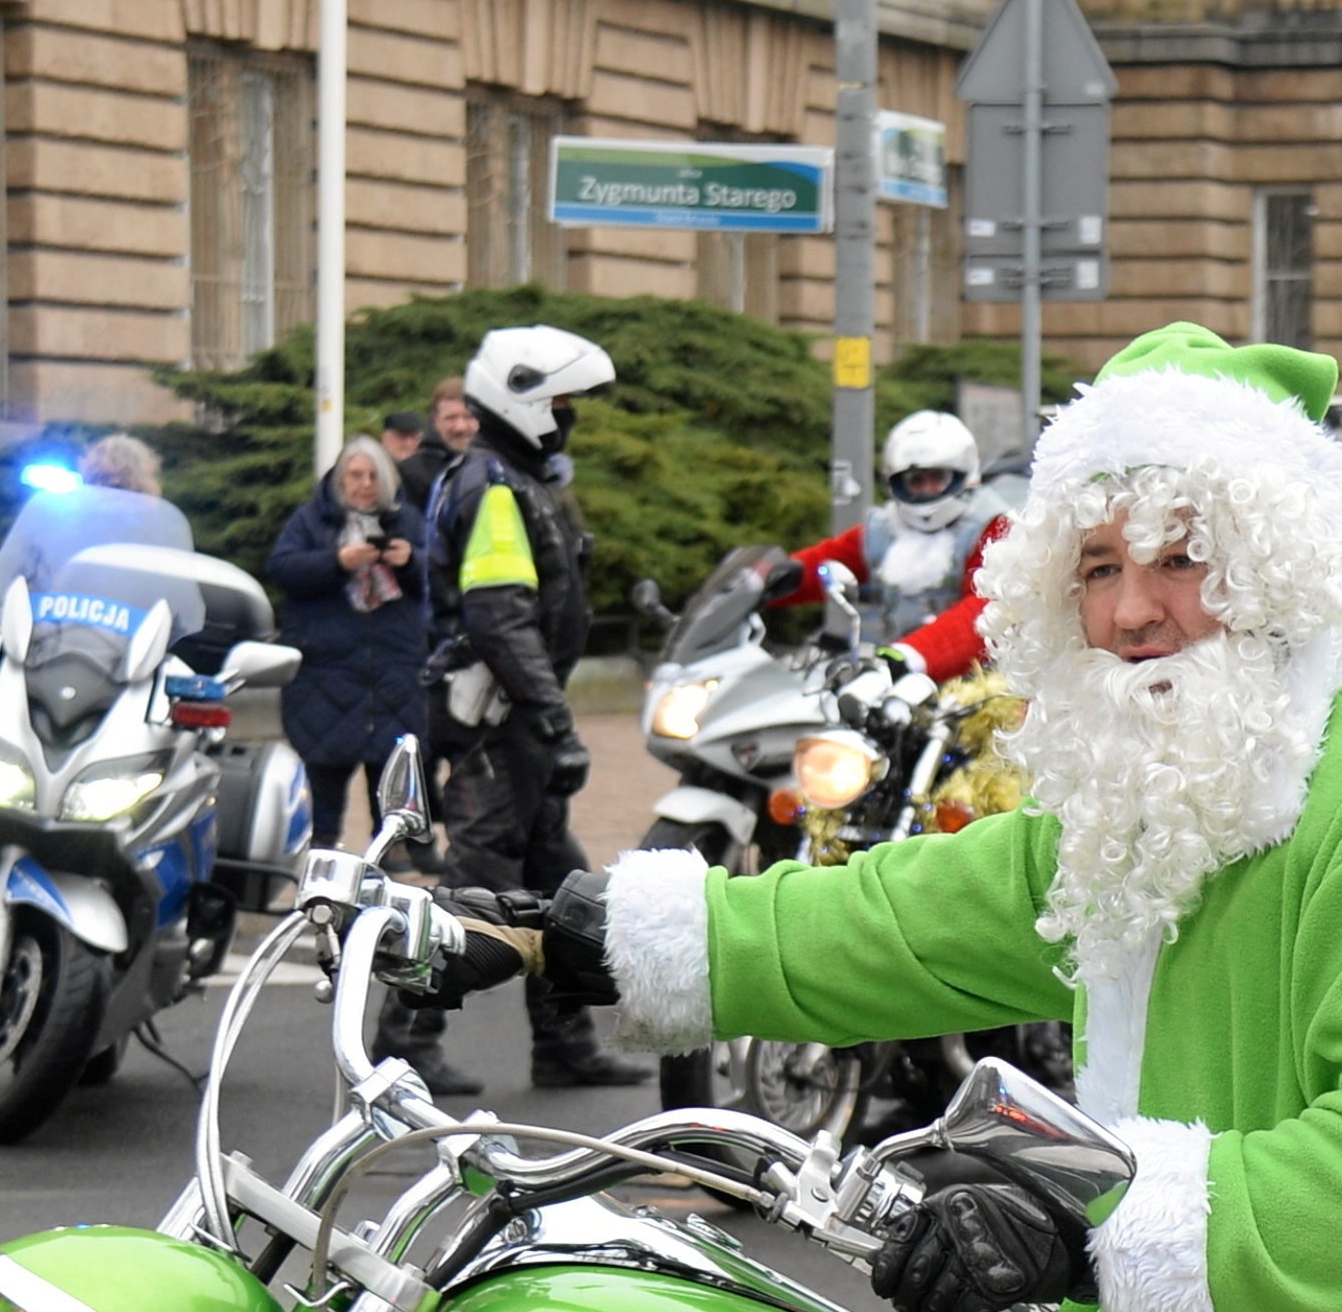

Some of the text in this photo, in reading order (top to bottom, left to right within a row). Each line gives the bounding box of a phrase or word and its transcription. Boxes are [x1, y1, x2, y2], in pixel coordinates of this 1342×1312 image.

[579, 176, 797, 213] Zygmunta Starego
[39, 595, 130, 631] POLICJA
